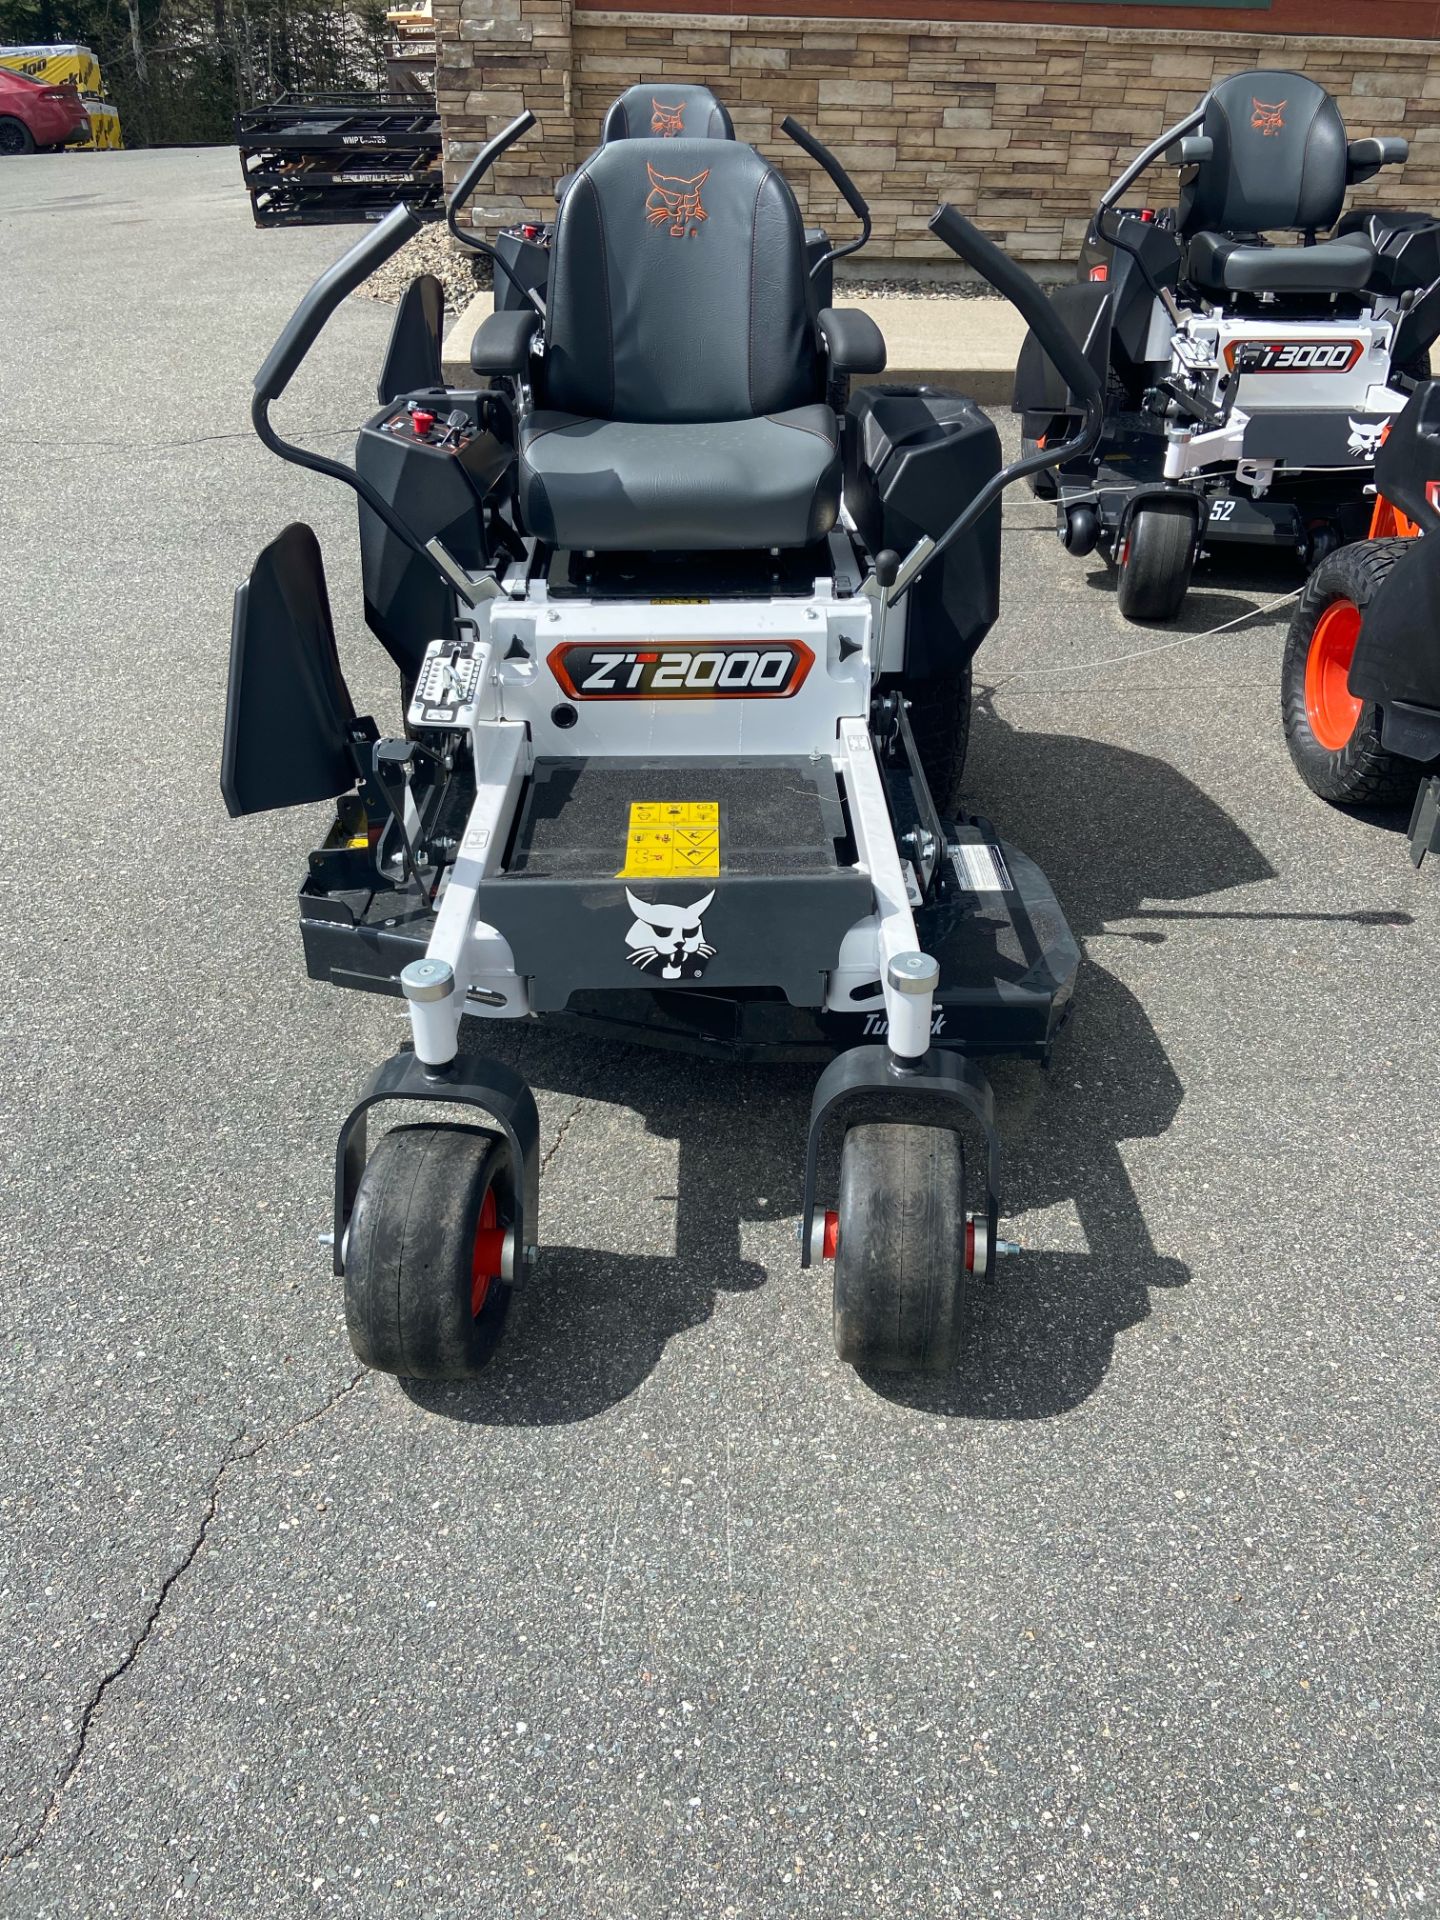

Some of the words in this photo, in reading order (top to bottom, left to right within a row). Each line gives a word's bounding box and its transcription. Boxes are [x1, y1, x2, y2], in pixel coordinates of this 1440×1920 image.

[1261, 346, 1352, 367] T3000
[1209, 500, 1236, 520] 52
[581, 652, 794, 689] ZT2000
